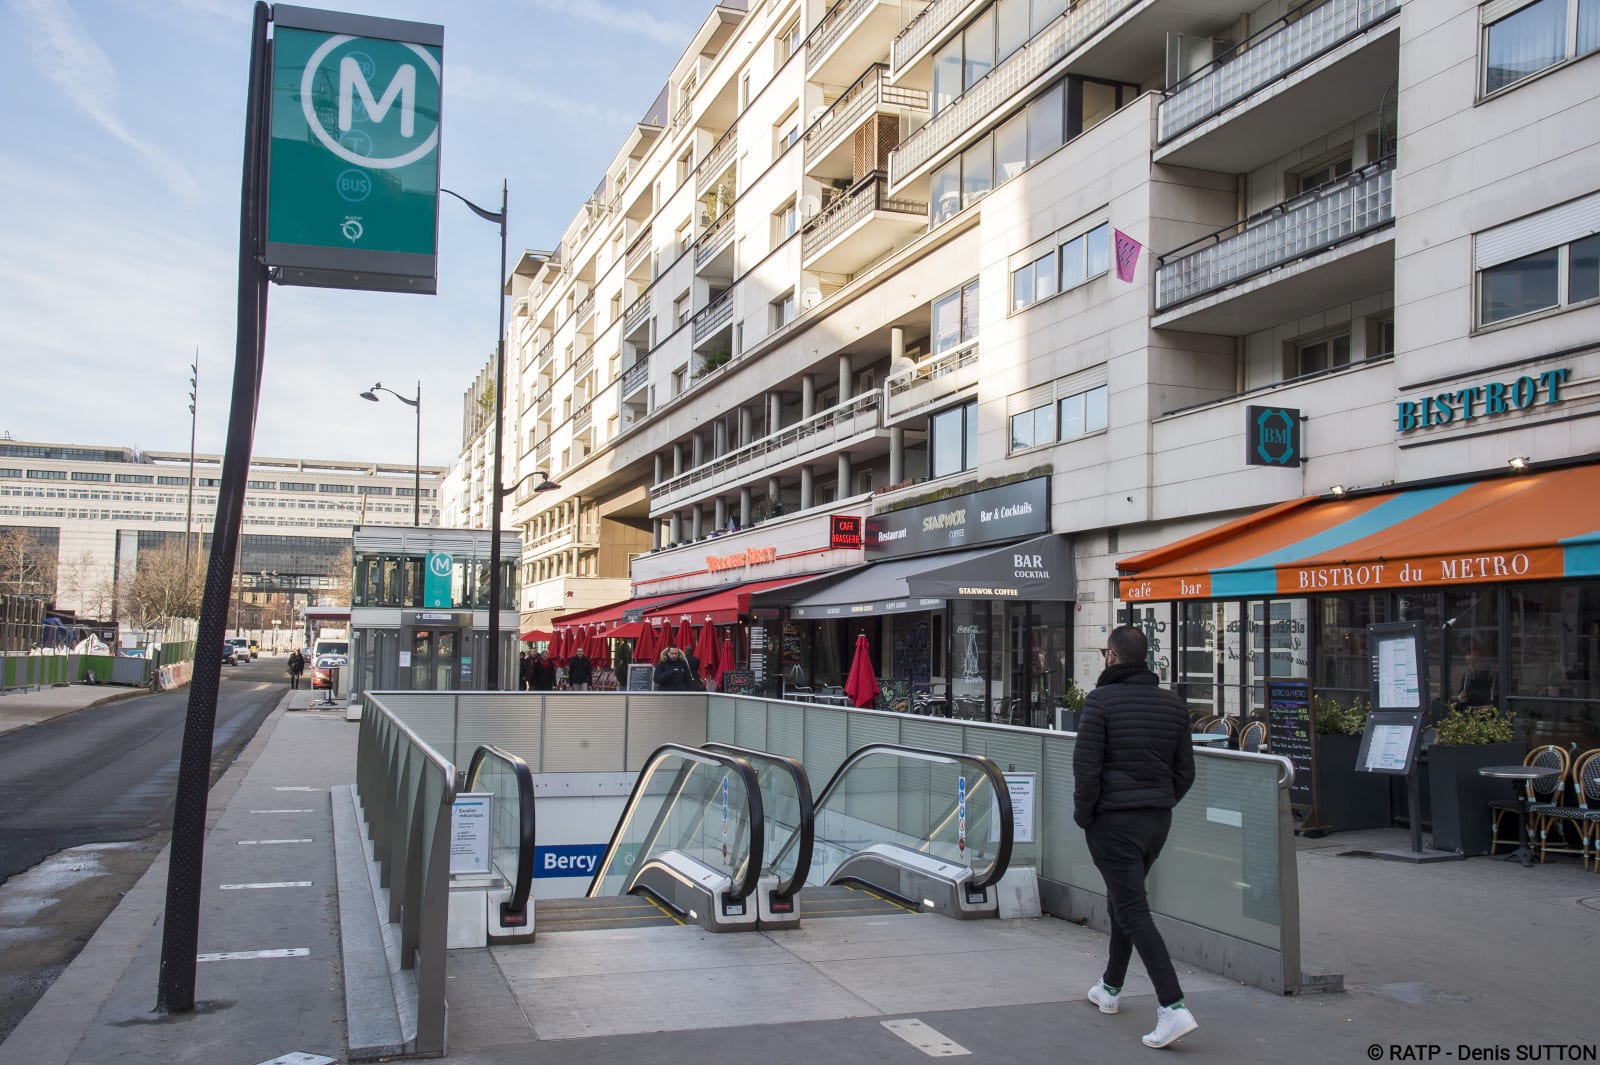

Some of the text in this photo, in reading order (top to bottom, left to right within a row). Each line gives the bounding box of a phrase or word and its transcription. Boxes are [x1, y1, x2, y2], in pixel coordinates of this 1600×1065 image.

[338, 56, 416, 138] M
[340, 177, 368, 192] BUS
[1396, 369, 1570, 432] BISTROT
[1263, 427, 1287, 444] BM
[980, 501, 1032, 523] Bar & Cocktails
[832, 534, 861, 544] BRASSERIE
[878, 527, 907, 542] Restaurant
[948, 528, 966, 538] COFFEE
[435, 557, 450, 571] M
[1013, 554, 1043, 568] BAR
[1014, 570, 1050, 579] COCKTAIL
[1298, 553, 1530, 588] BISTROT du METRO
[958, 587, 1019, 596] STARWOK COFFEE
[1128, 579, 1202, 598] café bar
[544, 852, 597, 872] Bercy
